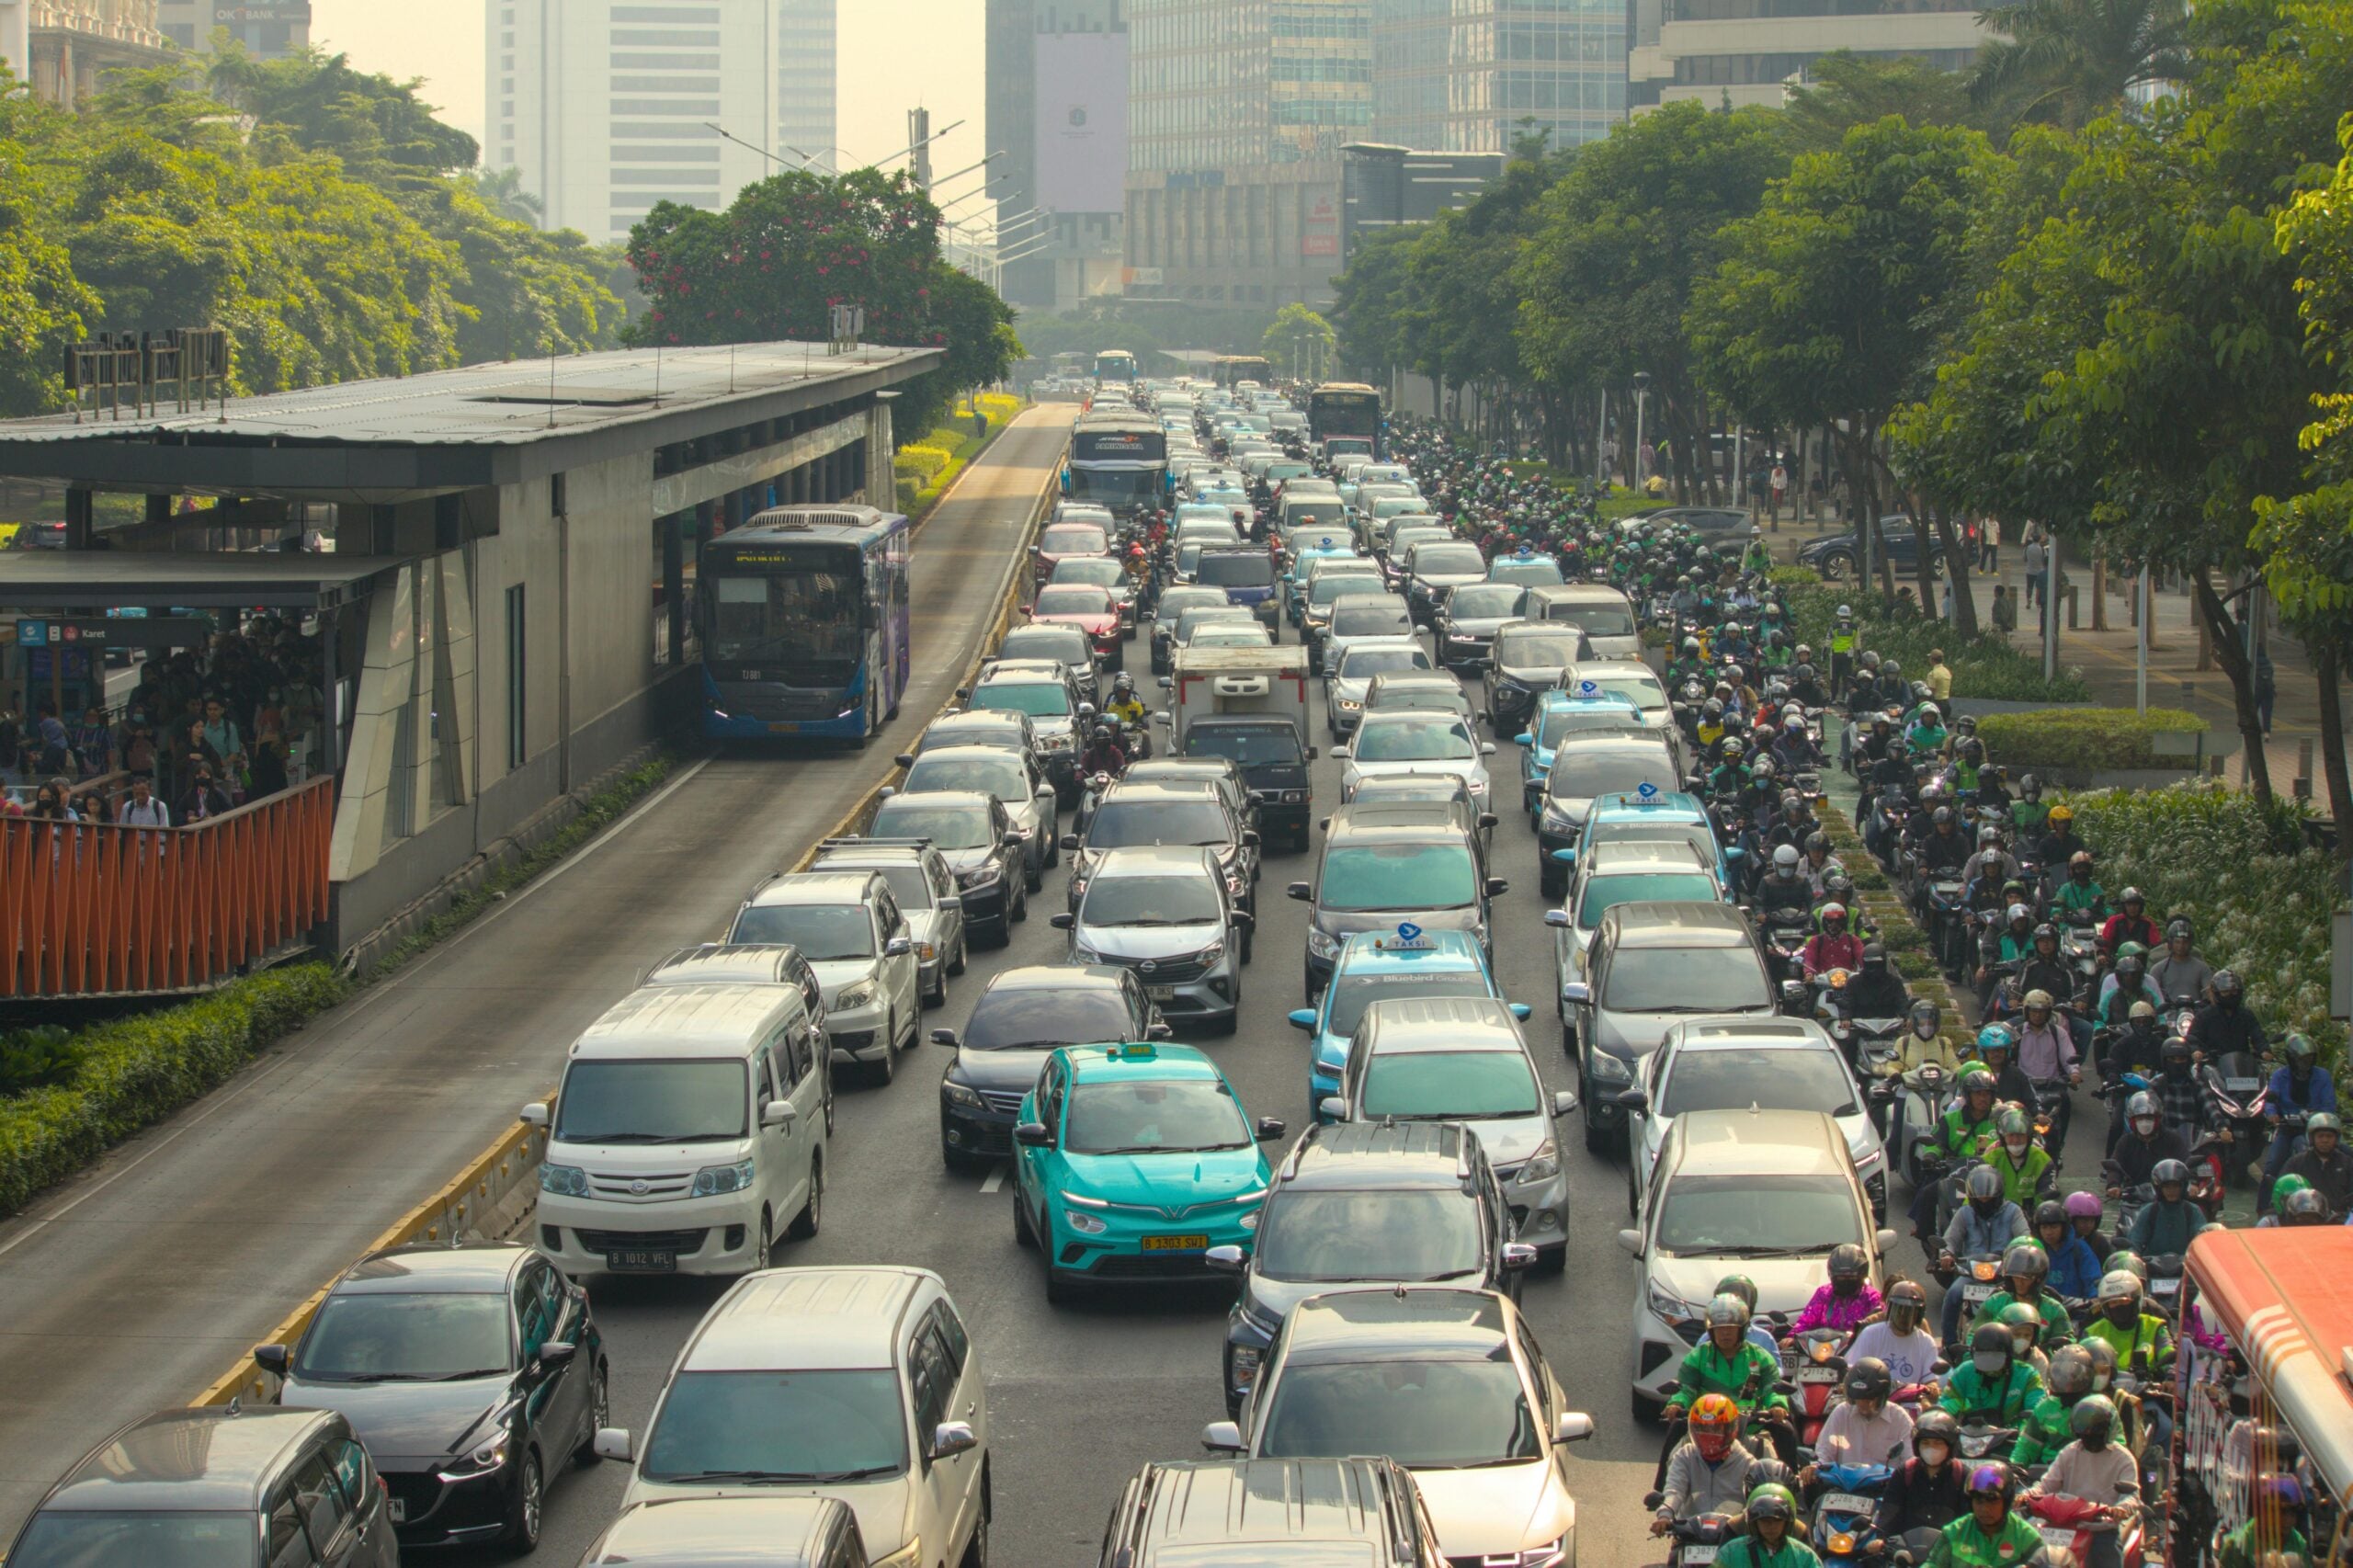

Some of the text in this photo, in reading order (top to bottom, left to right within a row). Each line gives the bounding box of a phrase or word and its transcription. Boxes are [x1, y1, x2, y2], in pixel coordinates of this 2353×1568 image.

[216, 9, 235, 19] OK
[245, 10, 274, 19] BANK
[82, 630, 106, 638] Karet
[1382, 974, 1469, 983] Bluebird Group
[1145, 1239, 1151, 1249] B
[1155, 1238, 1181, 1248] 1303
[612, 1253, 669, 1265] B 1012 VFL
